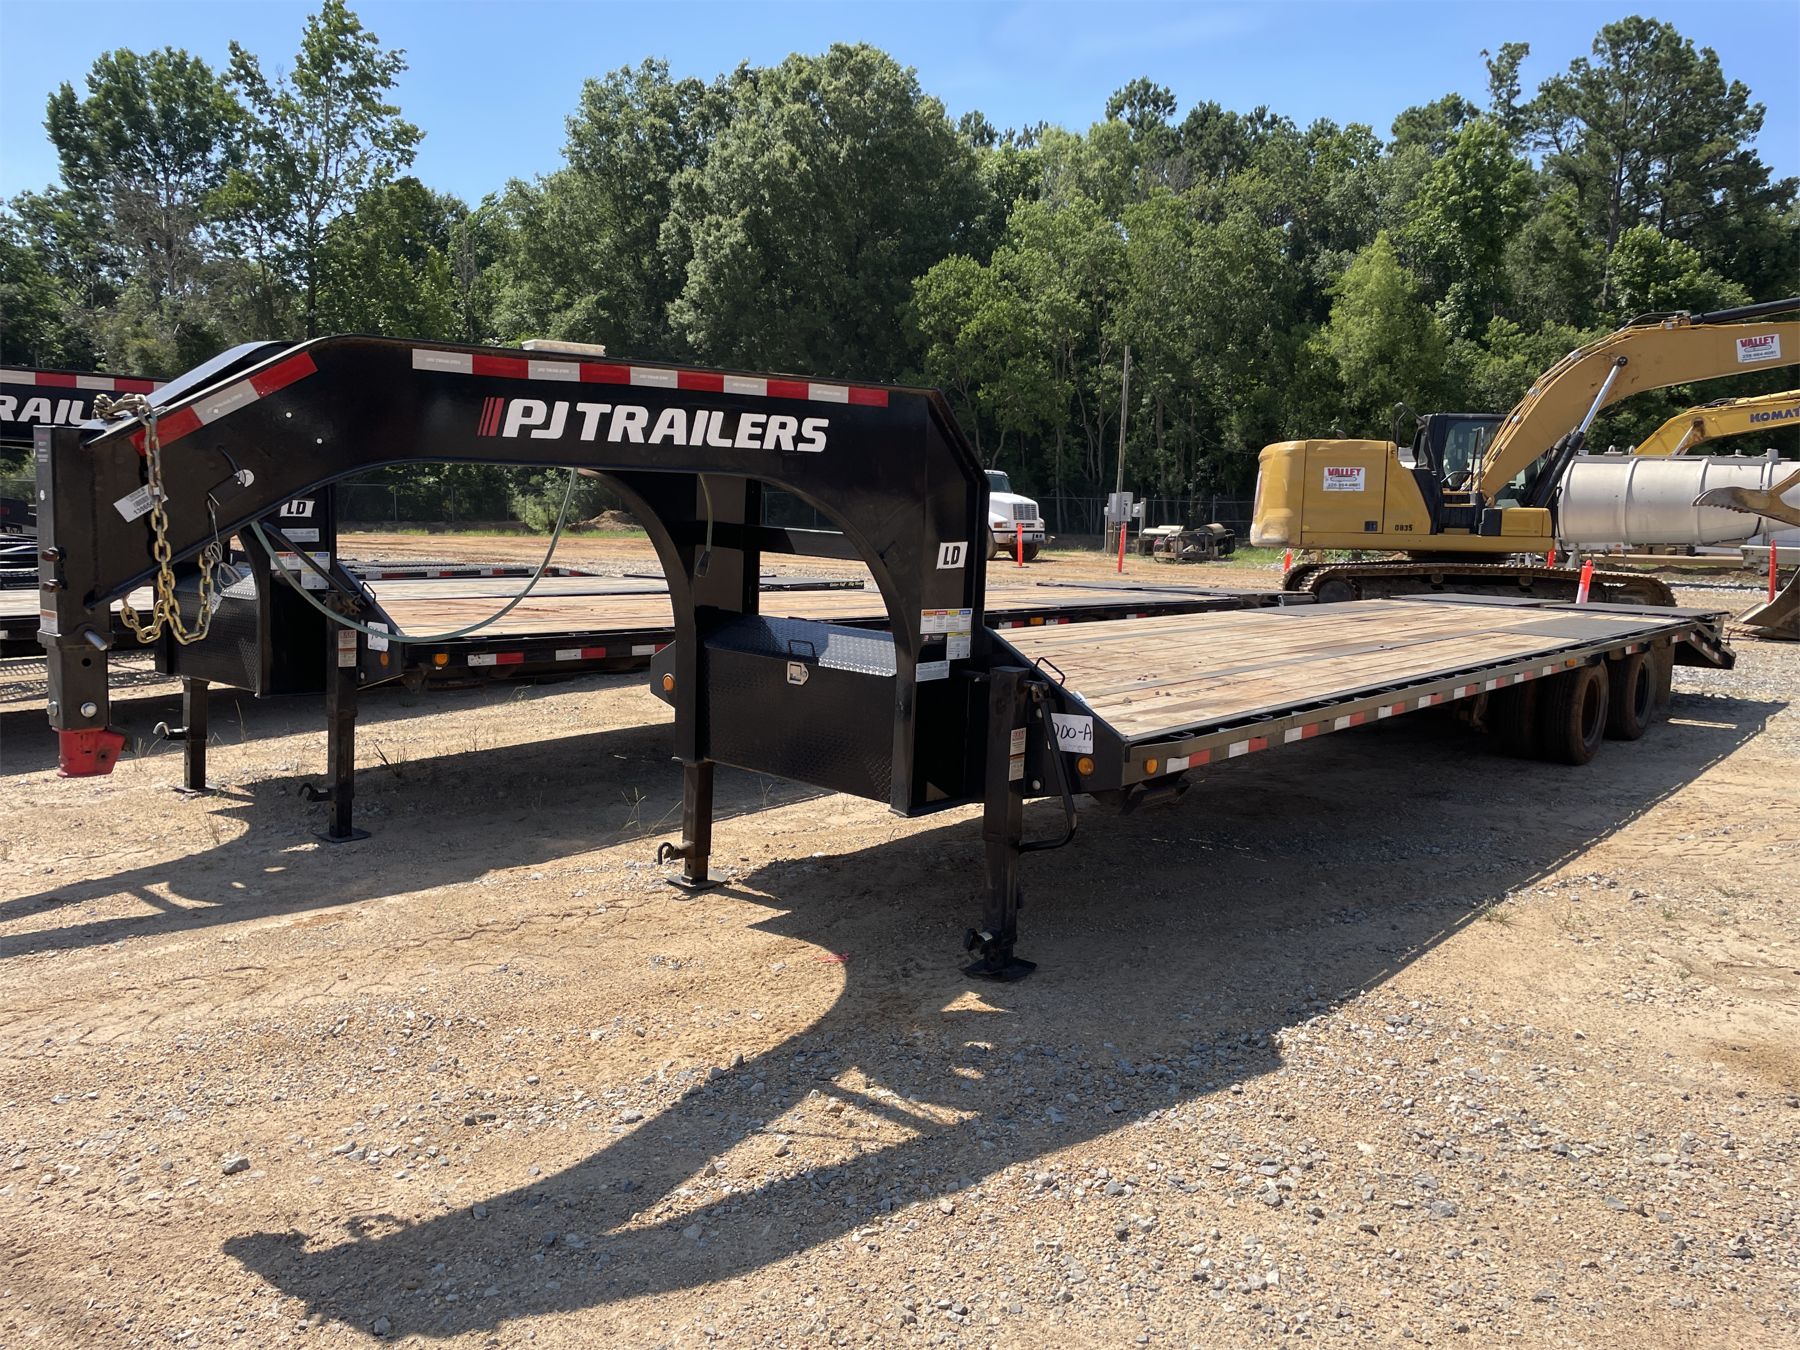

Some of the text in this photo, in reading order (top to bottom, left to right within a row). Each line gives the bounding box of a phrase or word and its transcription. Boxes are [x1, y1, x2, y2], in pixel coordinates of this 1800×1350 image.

[1740, 336, 1775, 347] VALLEY
[502, 398, 830, 453] PJ TRAILERS
[1328, 468, 1361, 477] VALLEY
[287, 501, 307, 515] LD
[943, 545, 961, 566] LD
